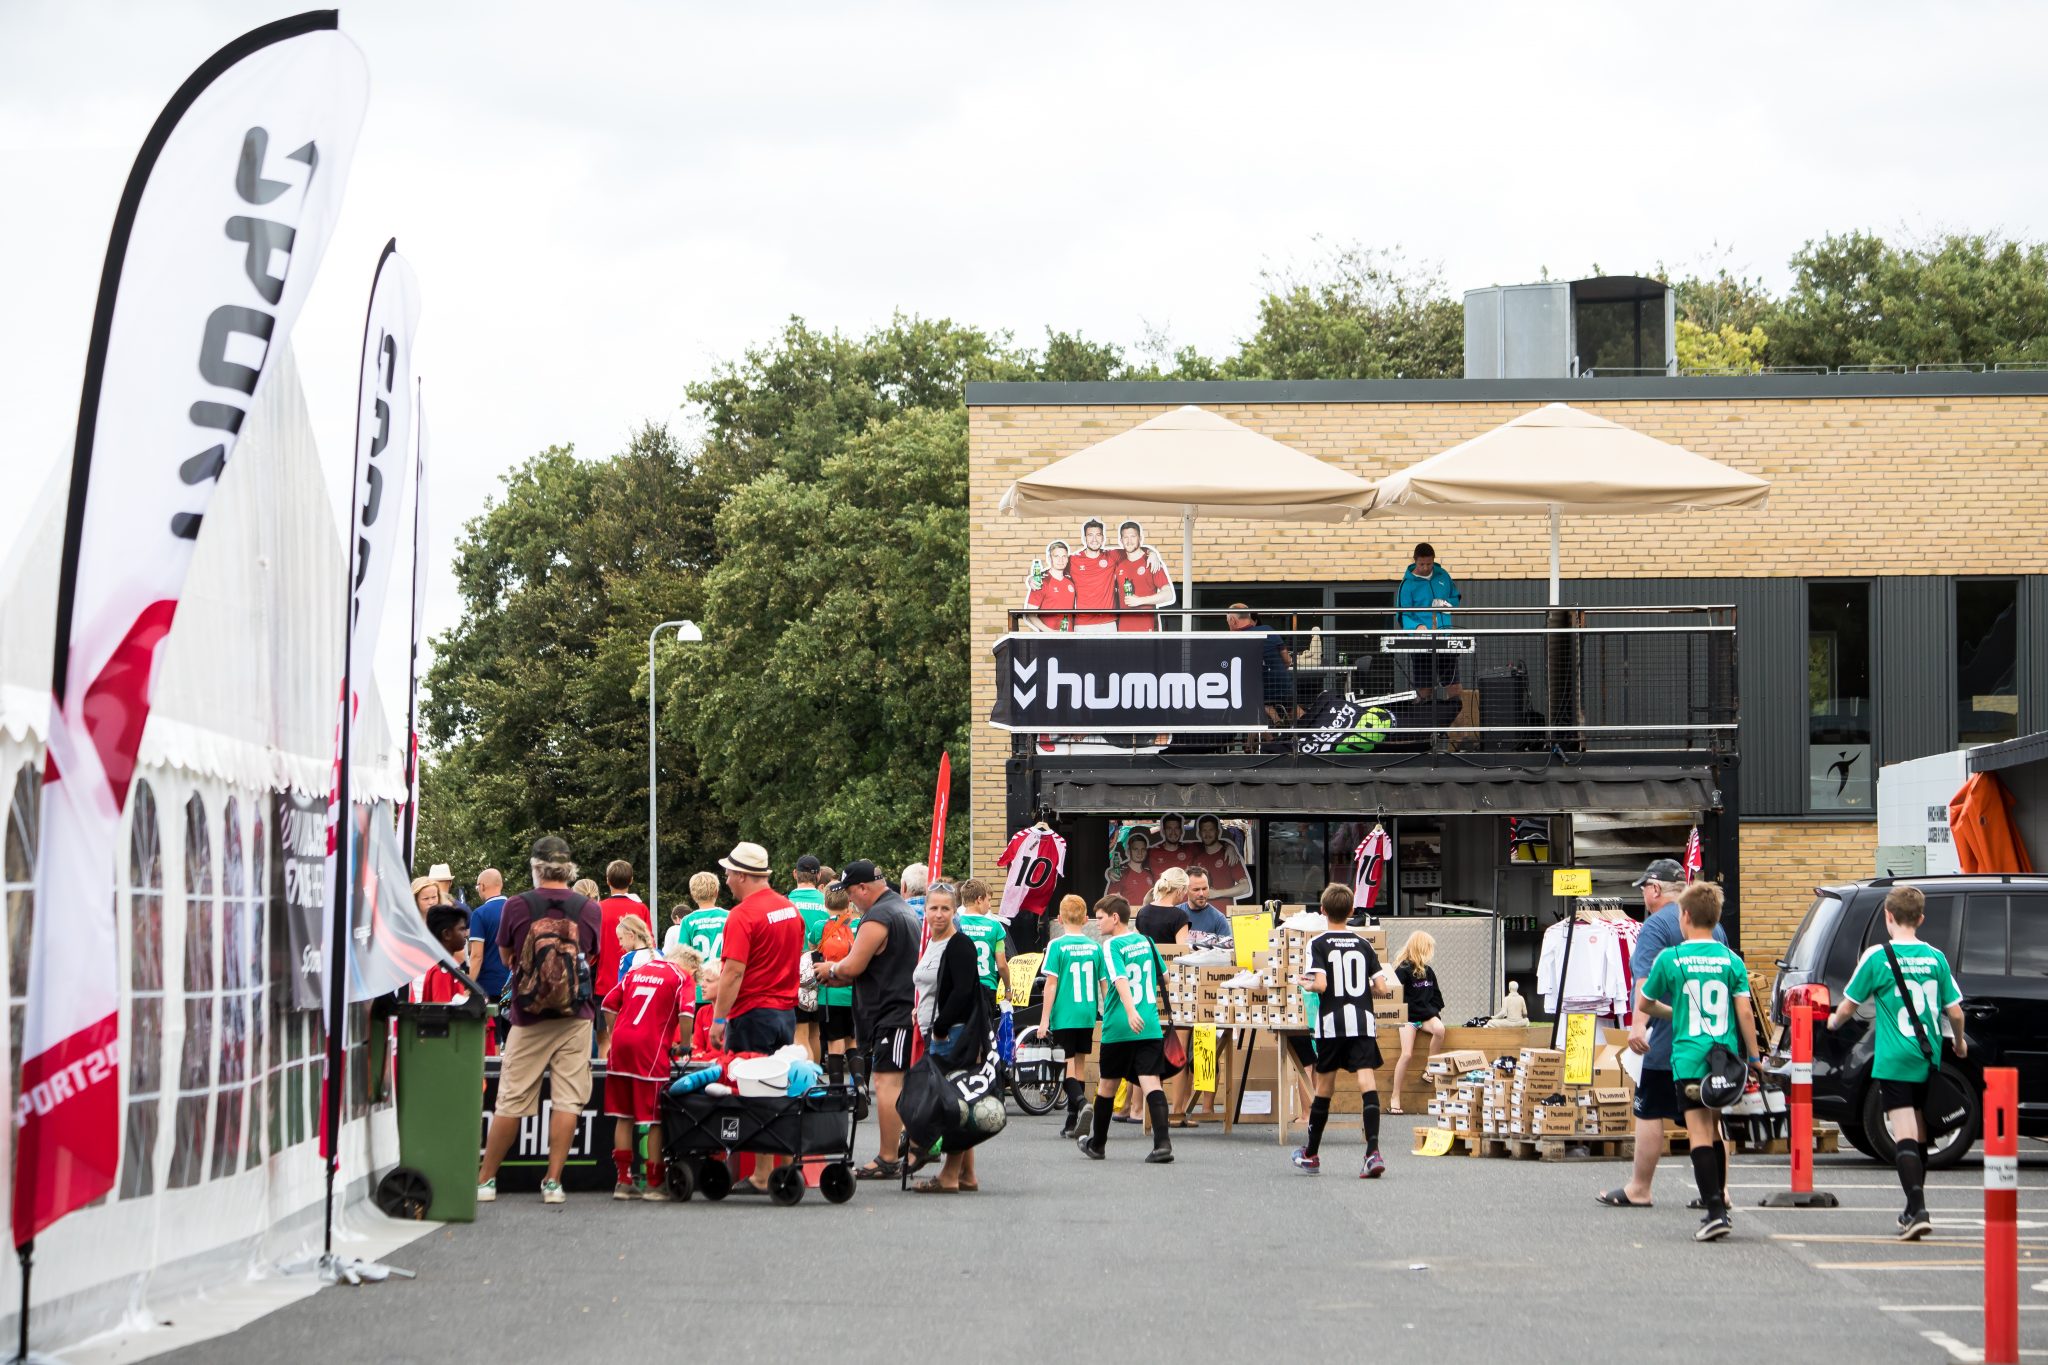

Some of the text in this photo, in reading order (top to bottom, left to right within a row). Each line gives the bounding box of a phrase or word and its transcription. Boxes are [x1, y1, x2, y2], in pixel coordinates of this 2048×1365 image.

[1046, 656, 1242, 710] hummel
[1015, 855, 1053, 889] 10
[632, 973, 664, 986] Morten
[1069, 960, 1095, 1003] 11
[1125, 959, 1156, 1005] 31
[1327, 949, 1366, 997] 10
[631, 985, 658, 1026] 7
[1682, 978, 1729, 1037] 19
[1894, 979, 1940, 1038] 21
[1600, 1091, 1626, 1099] hummel
[1602, 1110, 1627, 1118] hummel
